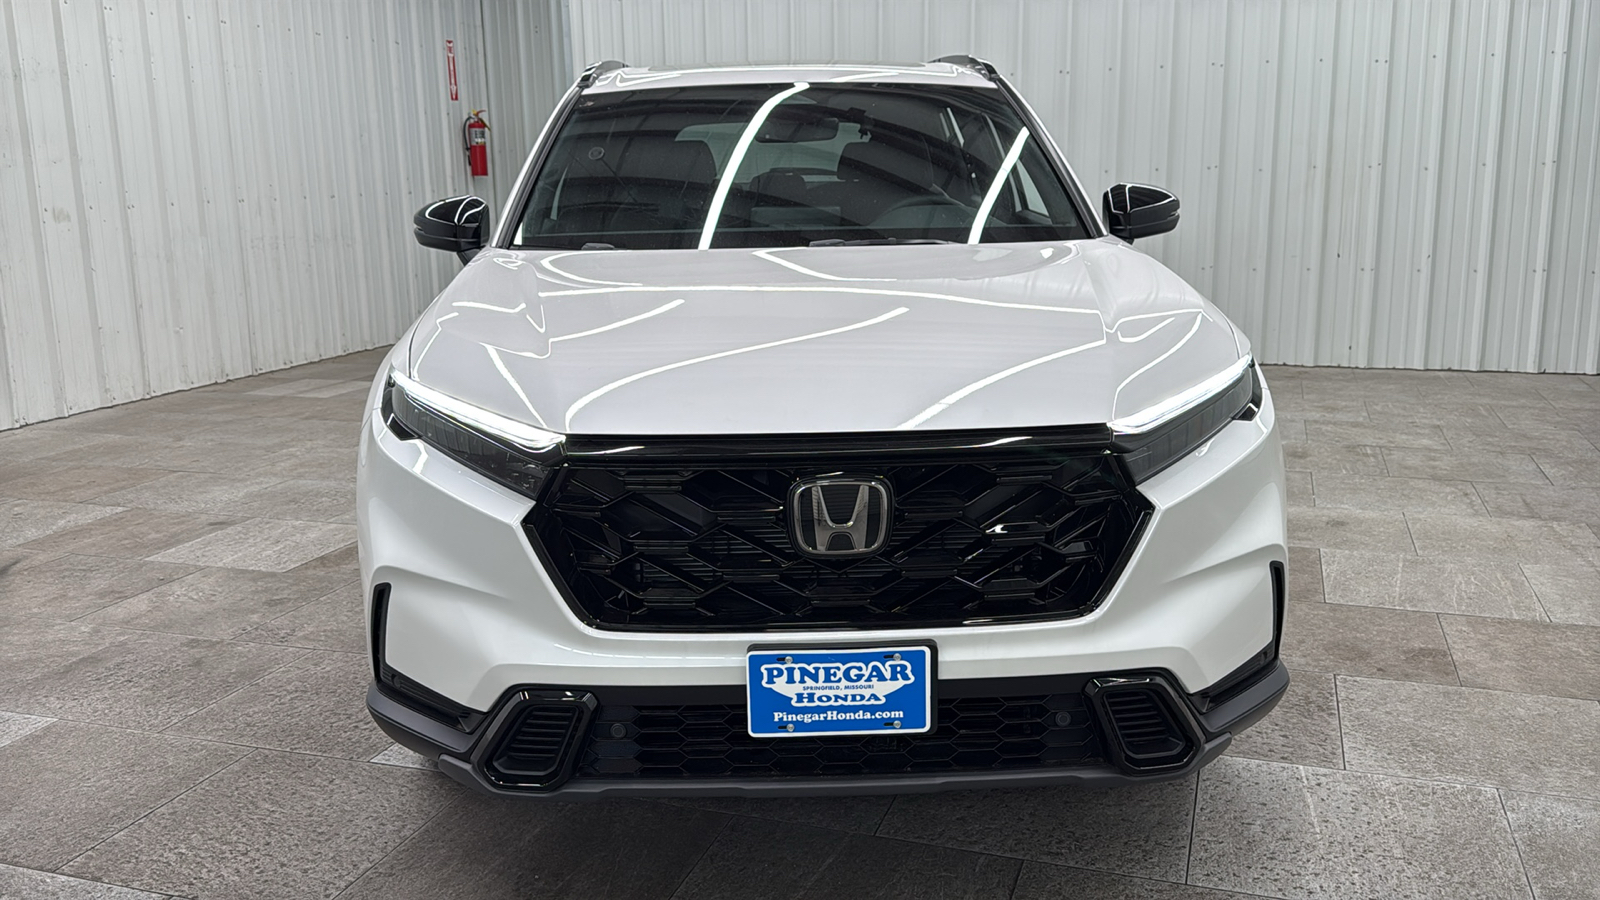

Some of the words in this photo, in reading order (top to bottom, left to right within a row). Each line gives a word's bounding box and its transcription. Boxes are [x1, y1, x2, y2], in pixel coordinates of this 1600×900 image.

[764, 663, 912, 685] PINEGAR
[794, 692, 883, 704] HONDA
[773, 710, 904, 723] PinegarHonda.com
